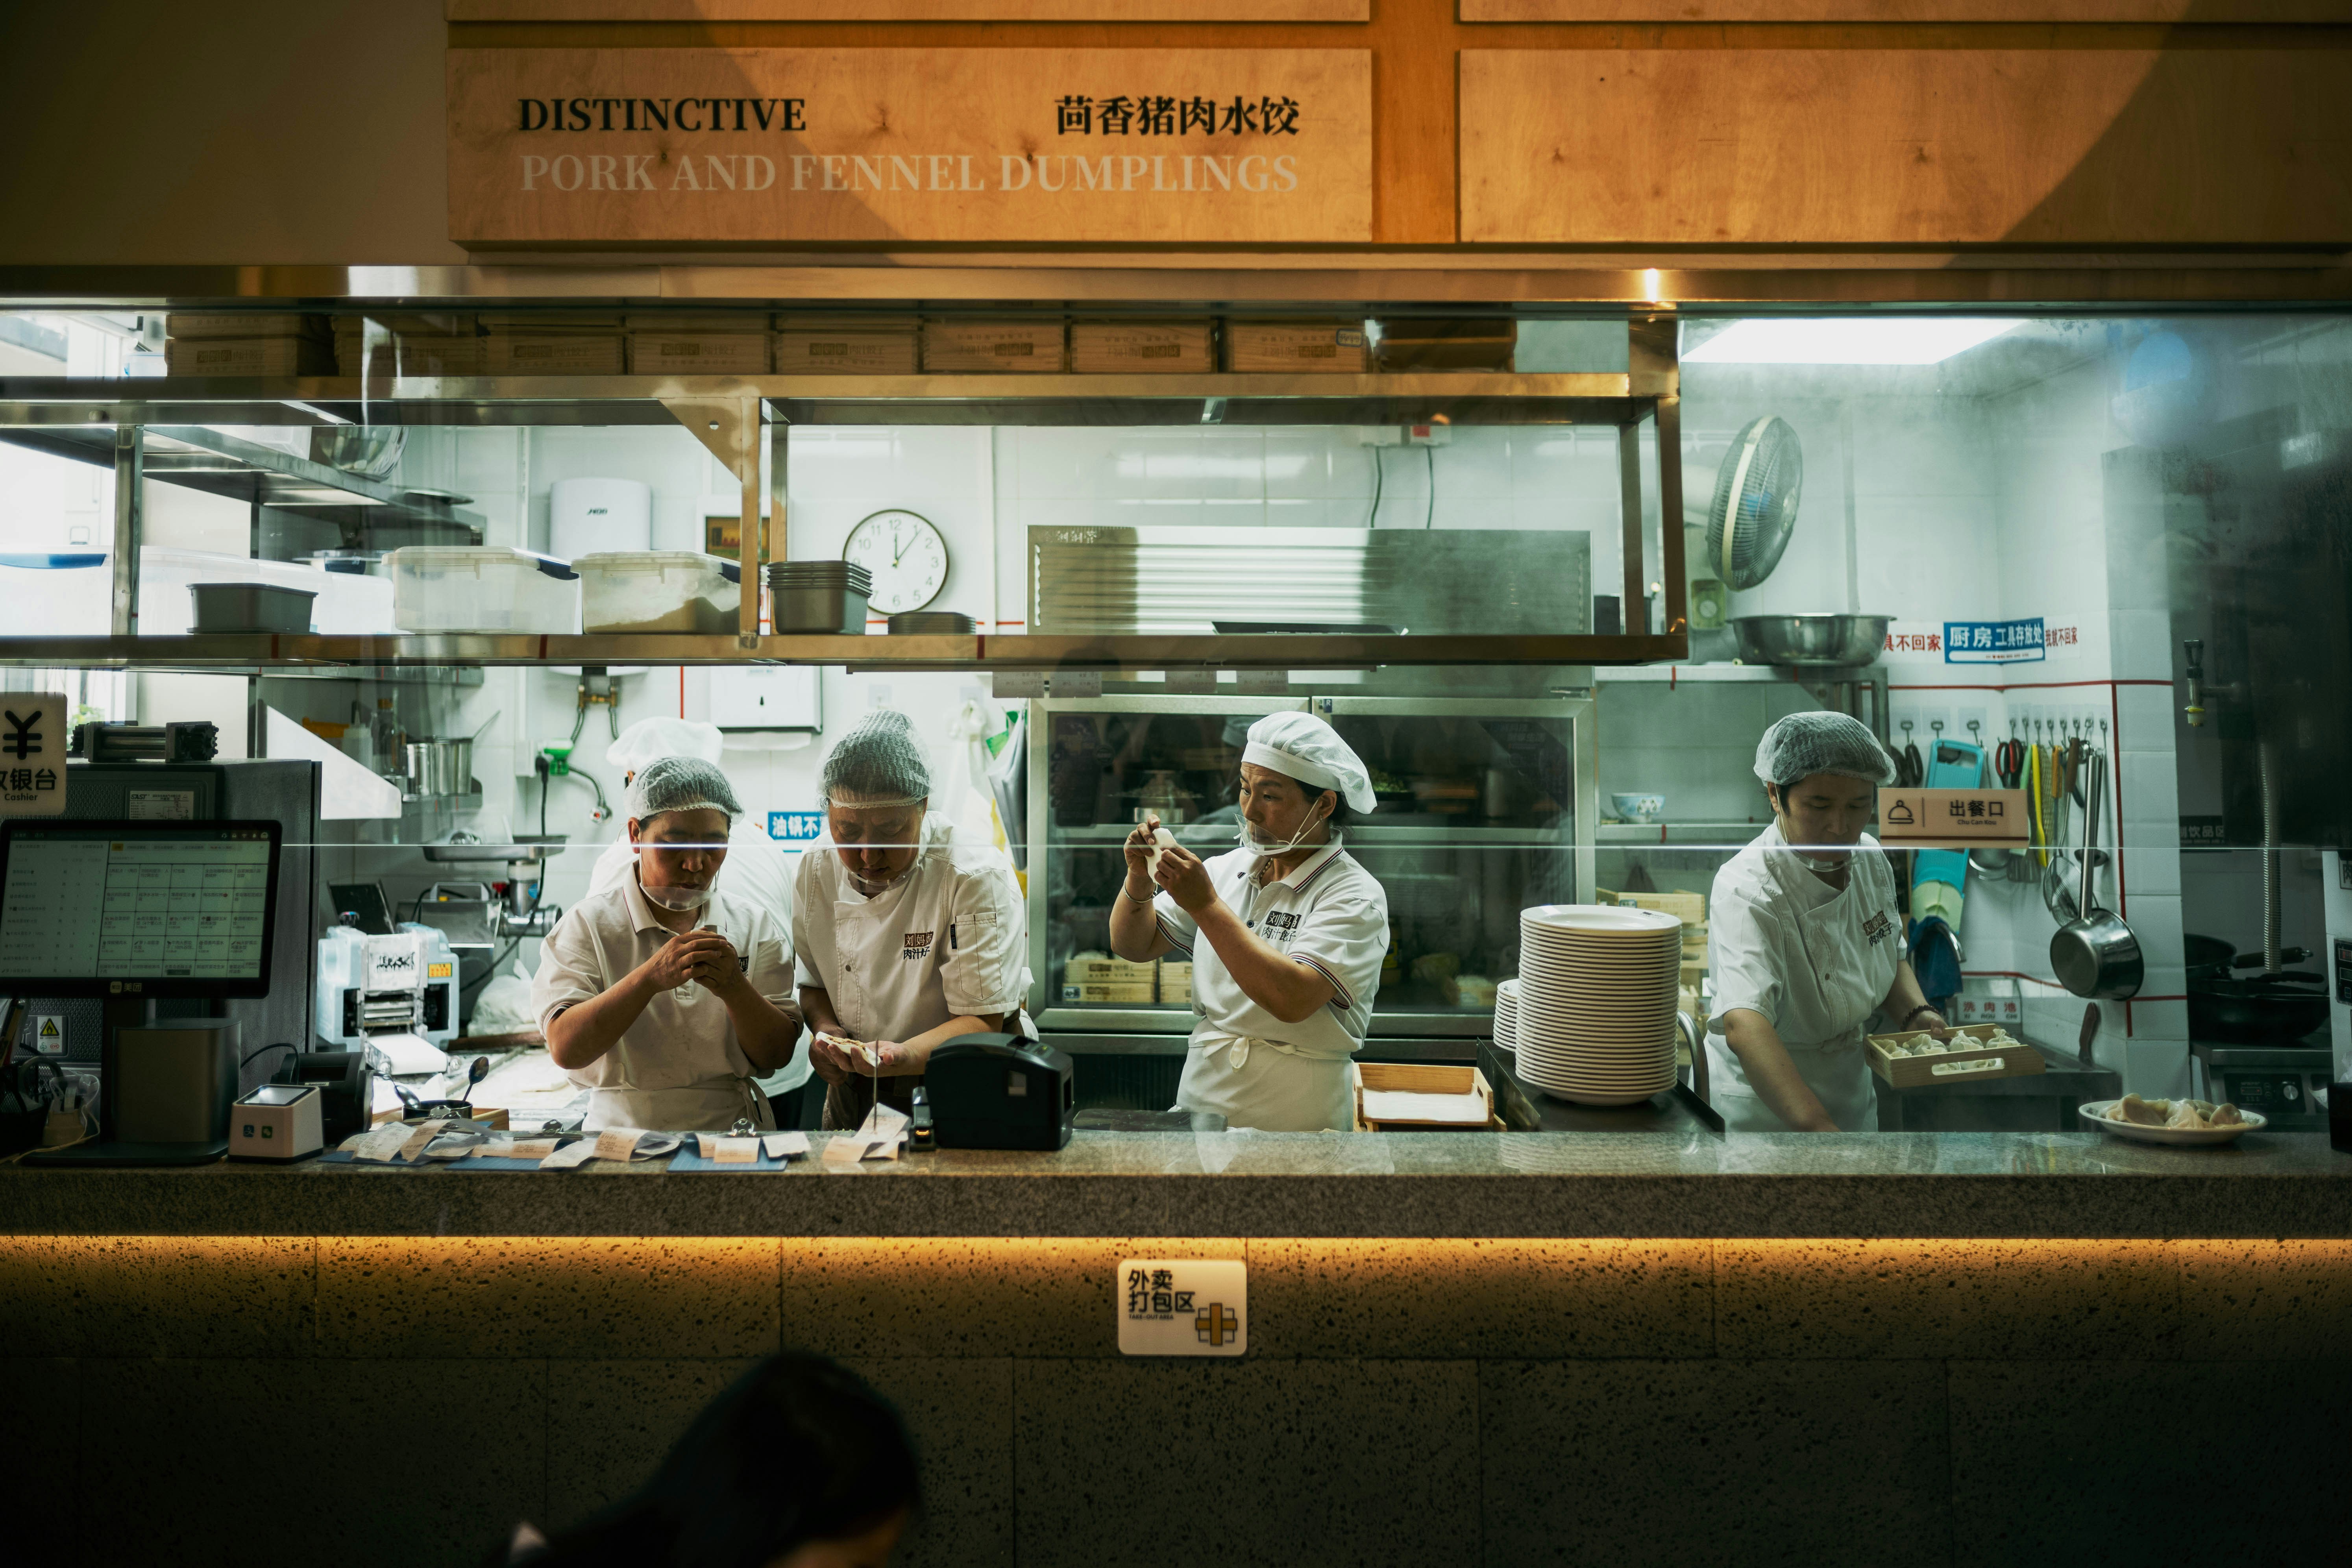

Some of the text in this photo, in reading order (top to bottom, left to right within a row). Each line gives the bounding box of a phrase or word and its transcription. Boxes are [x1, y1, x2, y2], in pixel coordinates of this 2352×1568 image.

[518, 98, 806, 131] DISTINCTIVE
[1054, 95, 1300, 136] 茴香猪肉水饺
[520, 154, 1298, 192] PORK AND FENNEL DUMPLINGS
[871, 525, 880, 536] 11
[889, 520, 901, 531] 12
[913, 524, 918, 535] 1
[858, 538, 871, 549] 10
[925, 538, 932, 549] 2
[931, 557, 939, 568] 3
[926, 576, 932, 586] 4
[893, 595, 900, 606] 6
[913, 590, 921, 601] 5
[2045, 627, 2078, 647] 我就不回家
[1950, 800, 2003, 817] 出餐口
[772, 815, 819, 838] 油锅不
[904, 946, 930, 960] 肉汁子
[123, 983, 142, 992] 美团
[1128, 1269, 1173, 1291] 外卖
[1128, 1290, 1195, 1313] 打包区
